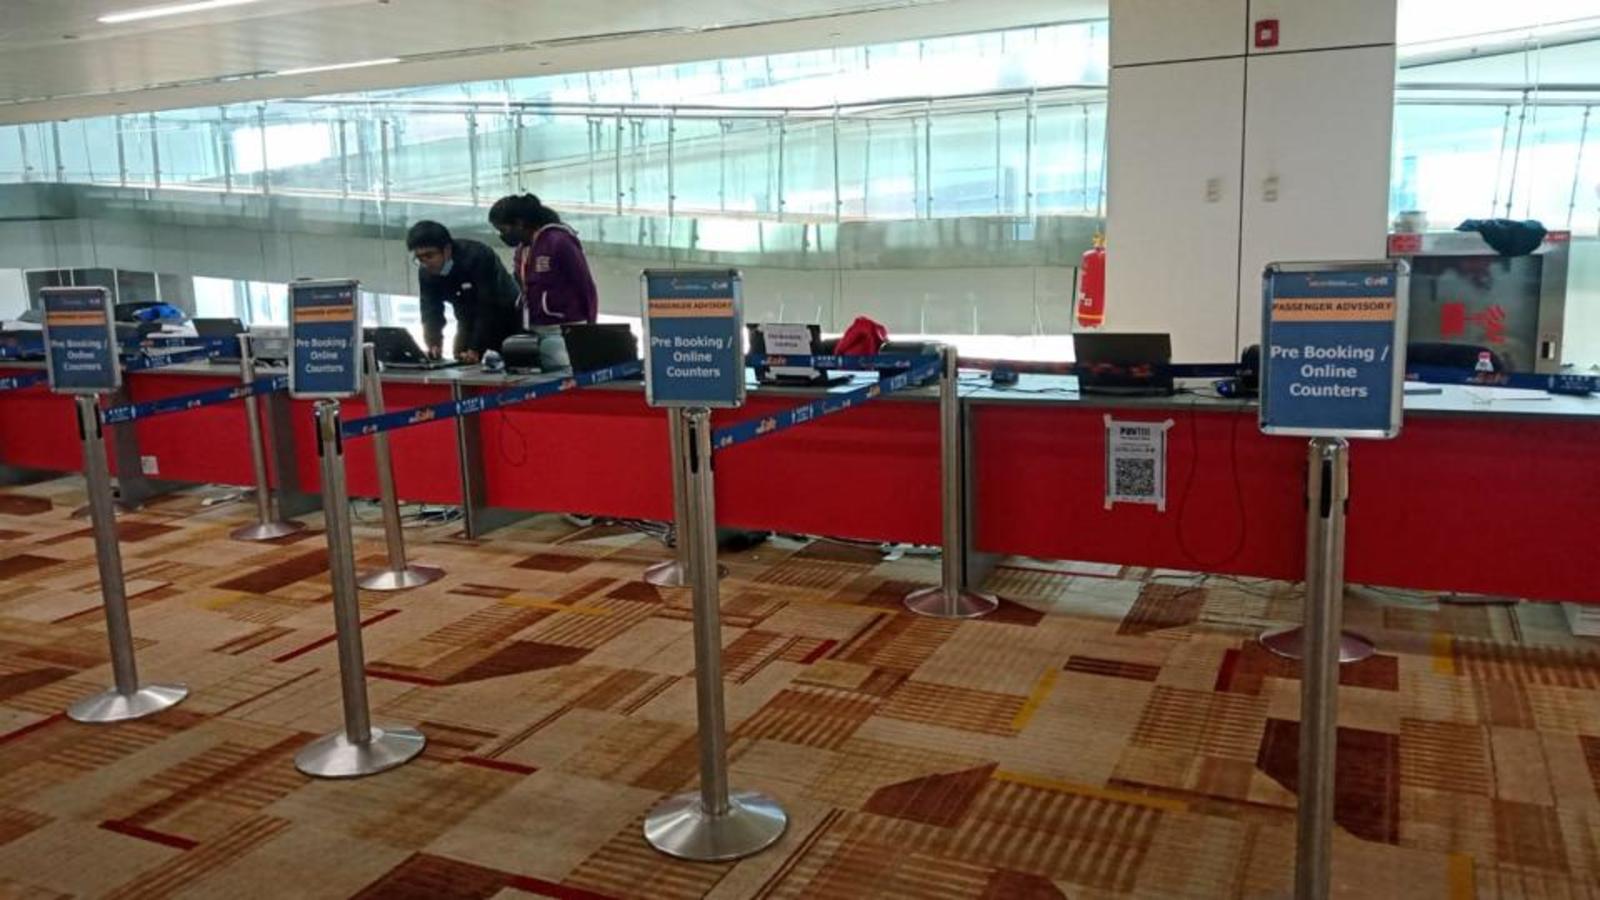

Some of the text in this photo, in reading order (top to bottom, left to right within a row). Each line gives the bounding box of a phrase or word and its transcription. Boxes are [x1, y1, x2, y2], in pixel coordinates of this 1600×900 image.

[1272, 301, 1392, 312] PASSENGER ADVISORY
[311, 337, 346, 349] Booking
[650, 336, 671, 347] Pre
[674, 335, 723, 349] Booking
[673, 350, 713, 362] Online
[1271, 344, 1390, 362] Pre Booking /
[666, 366, 721, 378] Counters
[1300, 363, 1358, 378] Online
[1289, 383, 1368, 398] Counters
